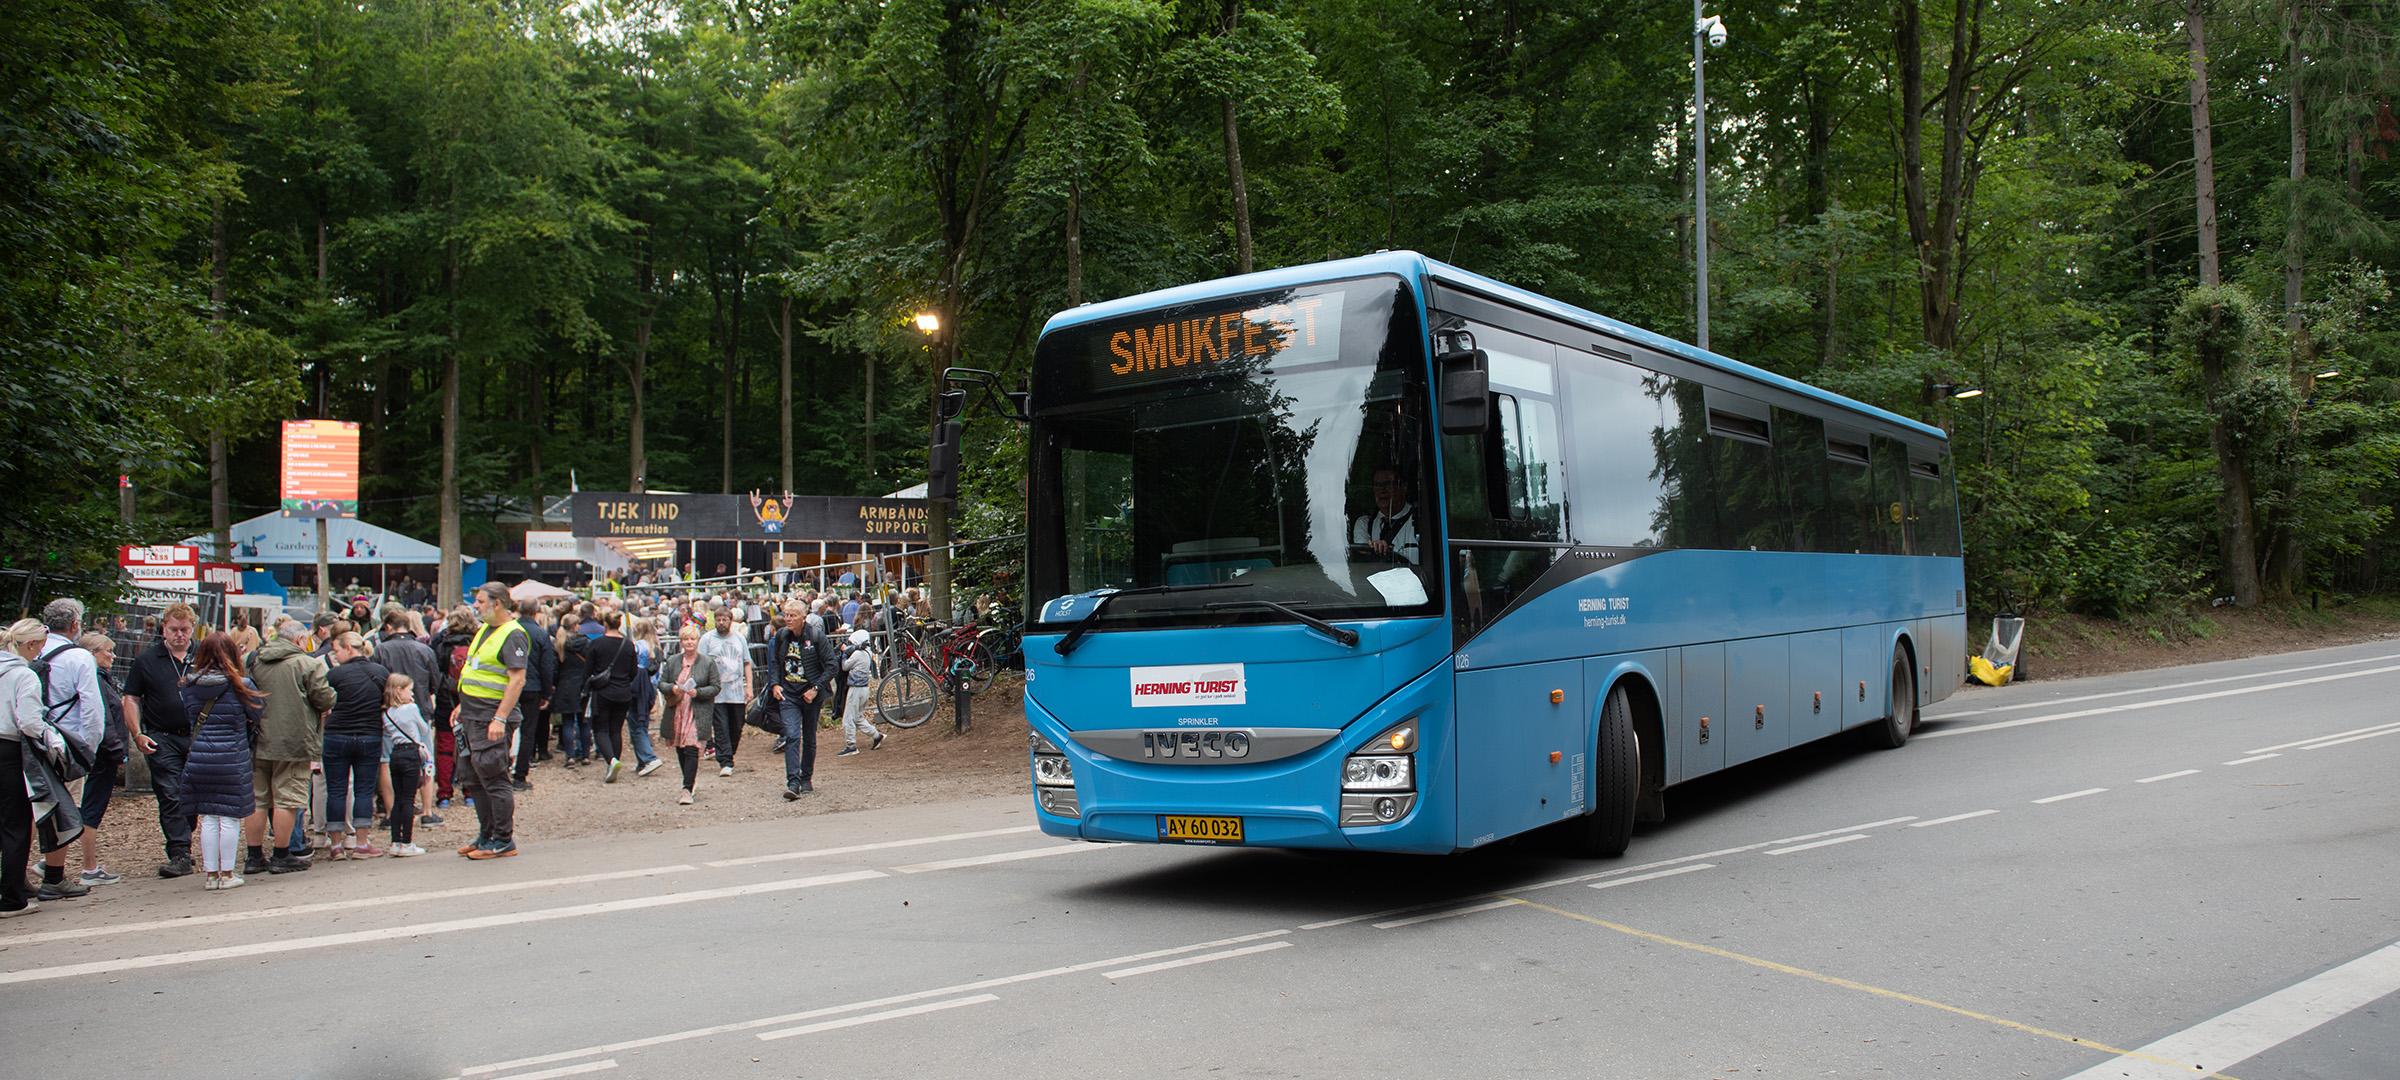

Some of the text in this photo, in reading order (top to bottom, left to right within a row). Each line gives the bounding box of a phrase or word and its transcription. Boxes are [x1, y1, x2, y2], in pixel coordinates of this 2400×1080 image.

[1110, 298, 1323, 375] SMUKFEST
[598, 502, 679, 520] TJEK IND
[860, 504, 928, 520] ARMBÅNDS
[610, 522, 669, 535] Information
[865, 520, 927, 534] SUPPORT
[275, 541, 331, 551] Gardero
[131, 568, 187, 576] PENGEKASSEN
[214, 570, 233, 578] CASH
[1578, 597, 1629, 611] HERNING TURIST
[1583, 614, 1627, 629] herning-turist.dk
[1456, 654, 1470, 669] 026
[1135, 680, 1238, 696] HERNING TURIST
[1178, 718, 1218, 726] SPRINKLER
[1144, 731, 1249, 758] IVECO
[1169, 819, 1239, 836] AY 60 032
